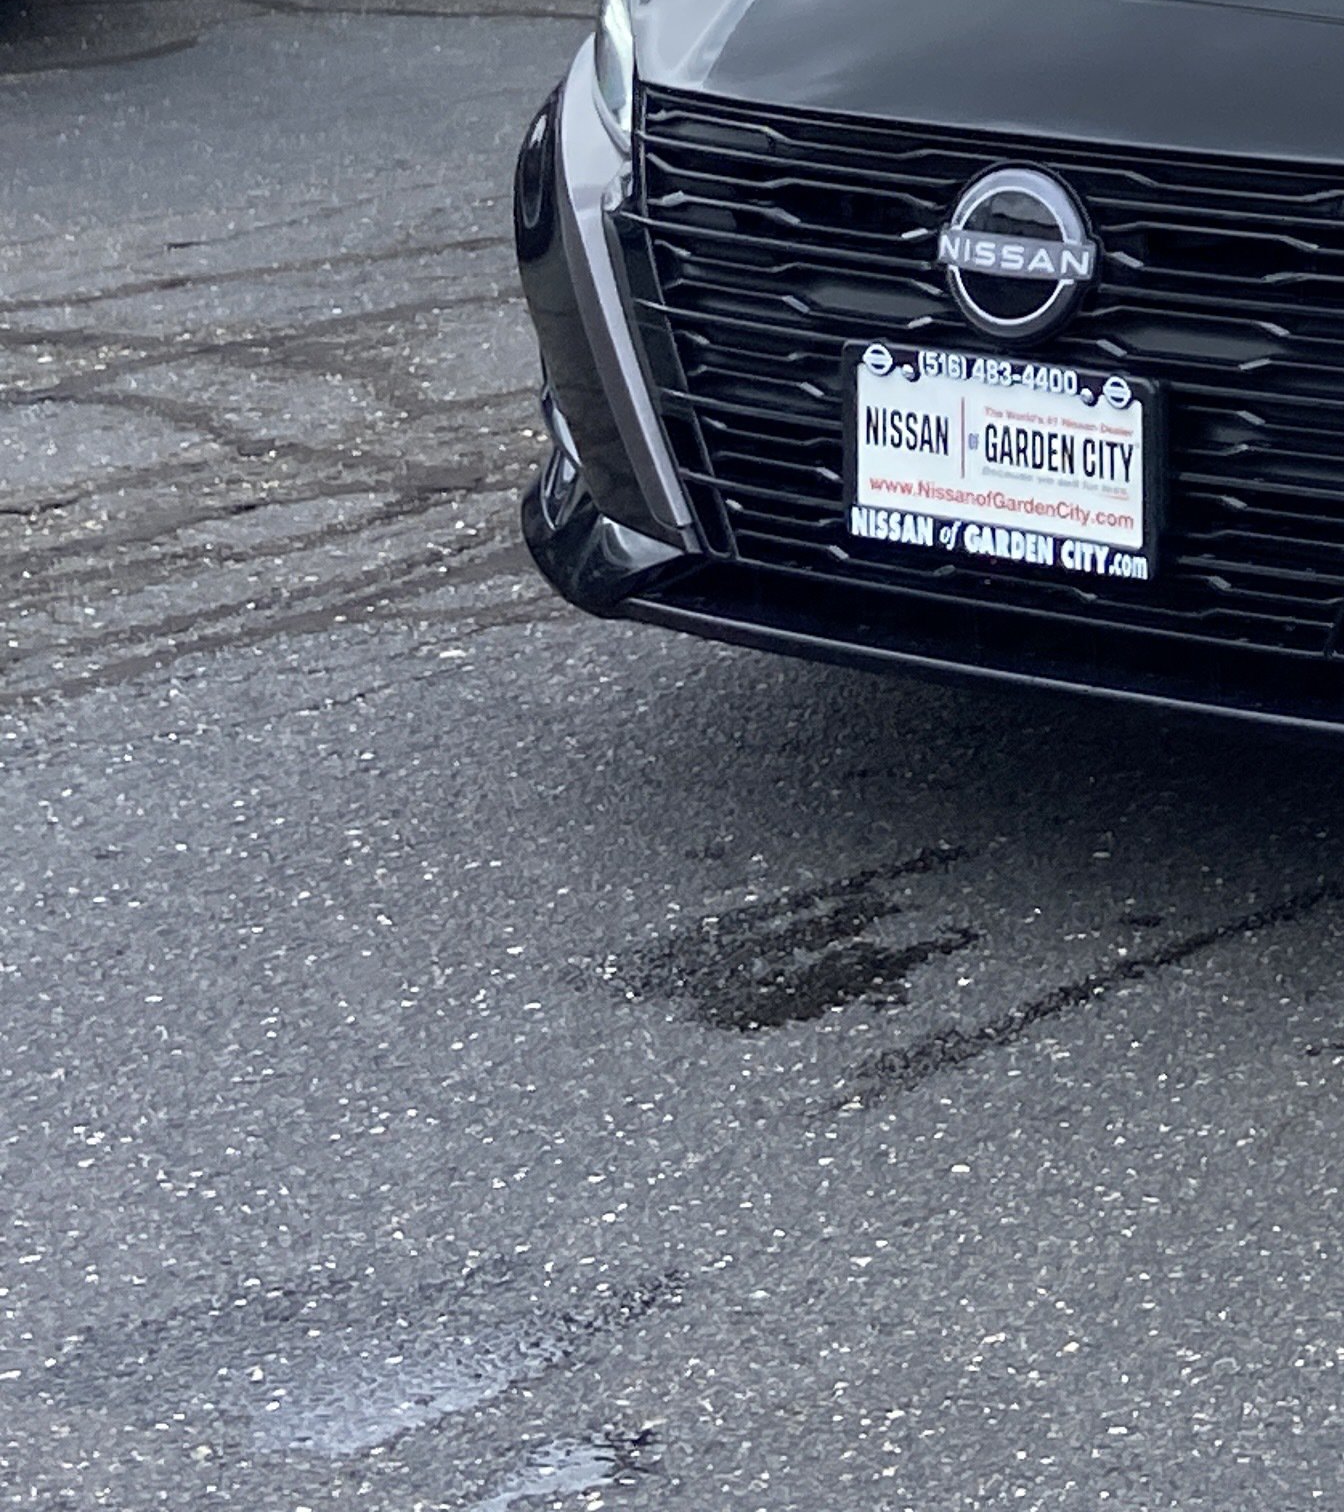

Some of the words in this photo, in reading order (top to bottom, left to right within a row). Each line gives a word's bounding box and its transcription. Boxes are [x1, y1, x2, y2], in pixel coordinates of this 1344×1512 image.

[938, 234, 1089, 275] NISSAN
[917, 351, 967, 380] (516)
[971, 357, 1078, 395] 483-4400
[866, 405, 949, 456] NISSAN
[985, 423, 1075, 475] GARDEN
[1083, 438, 1134, 483] CITY
[869, 477, 1135, 529] www.NissanofGardenCity.com
[851, 506, 934, 546] NISSAN
[939, 521, 961, 550] of
[964, 524, 1054, 565] GARDEN
[1061, 541, 1148, 580] CITY.com
